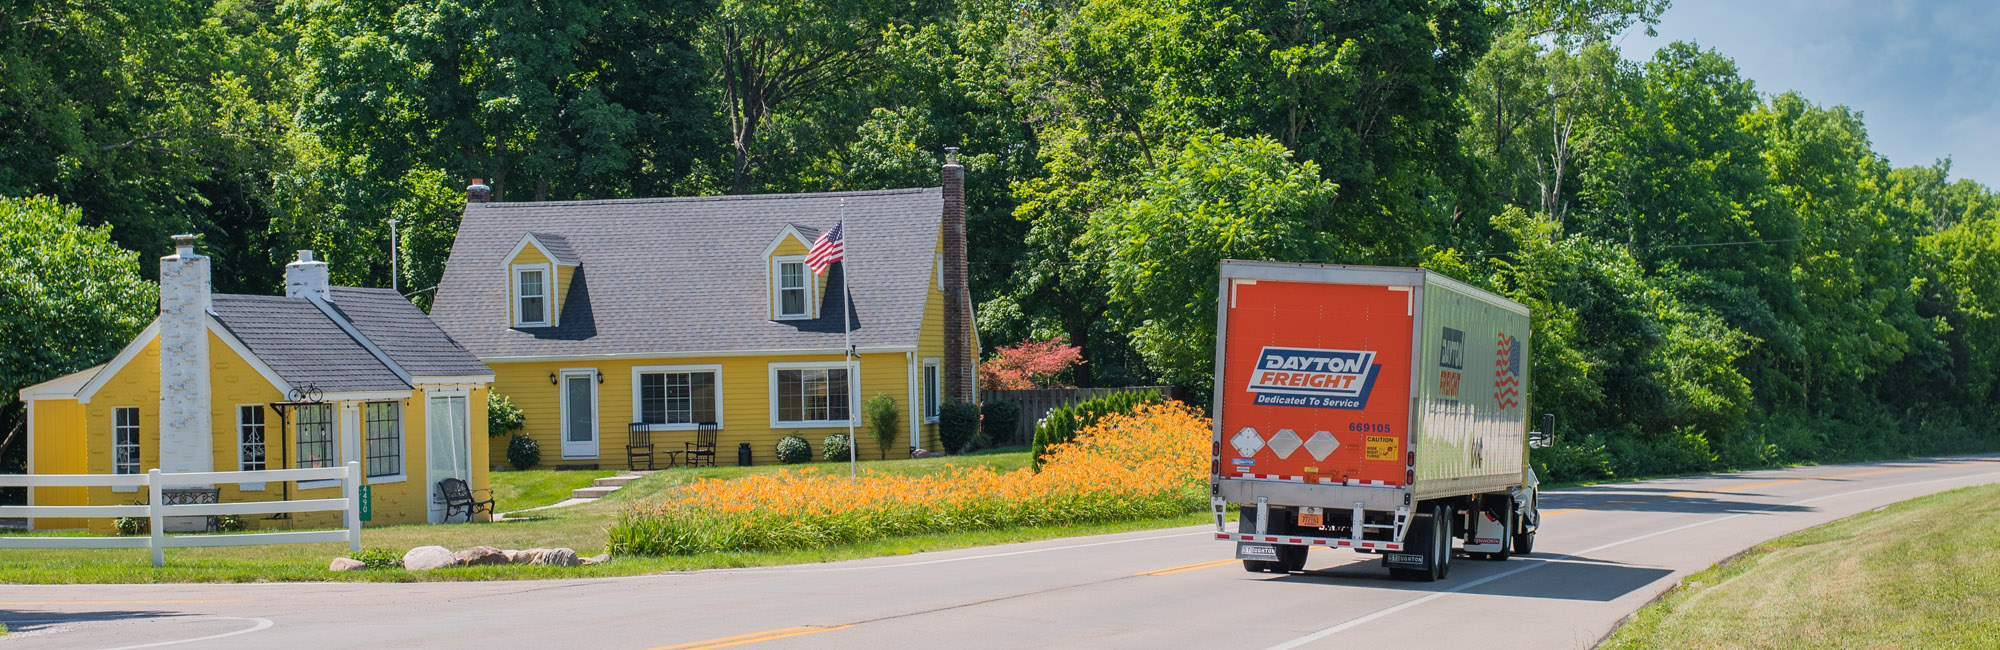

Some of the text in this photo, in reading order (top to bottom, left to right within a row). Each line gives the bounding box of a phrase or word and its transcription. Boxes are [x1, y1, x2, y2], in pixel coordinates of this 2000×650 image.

[1265, 355, 1364, 373] DAYTON
[1259, 371, 1357, 389] FREIGHT
[1257, 394, 1360, 408] Dedicated To Service
[1348, 422, 1391, 433] 669105
